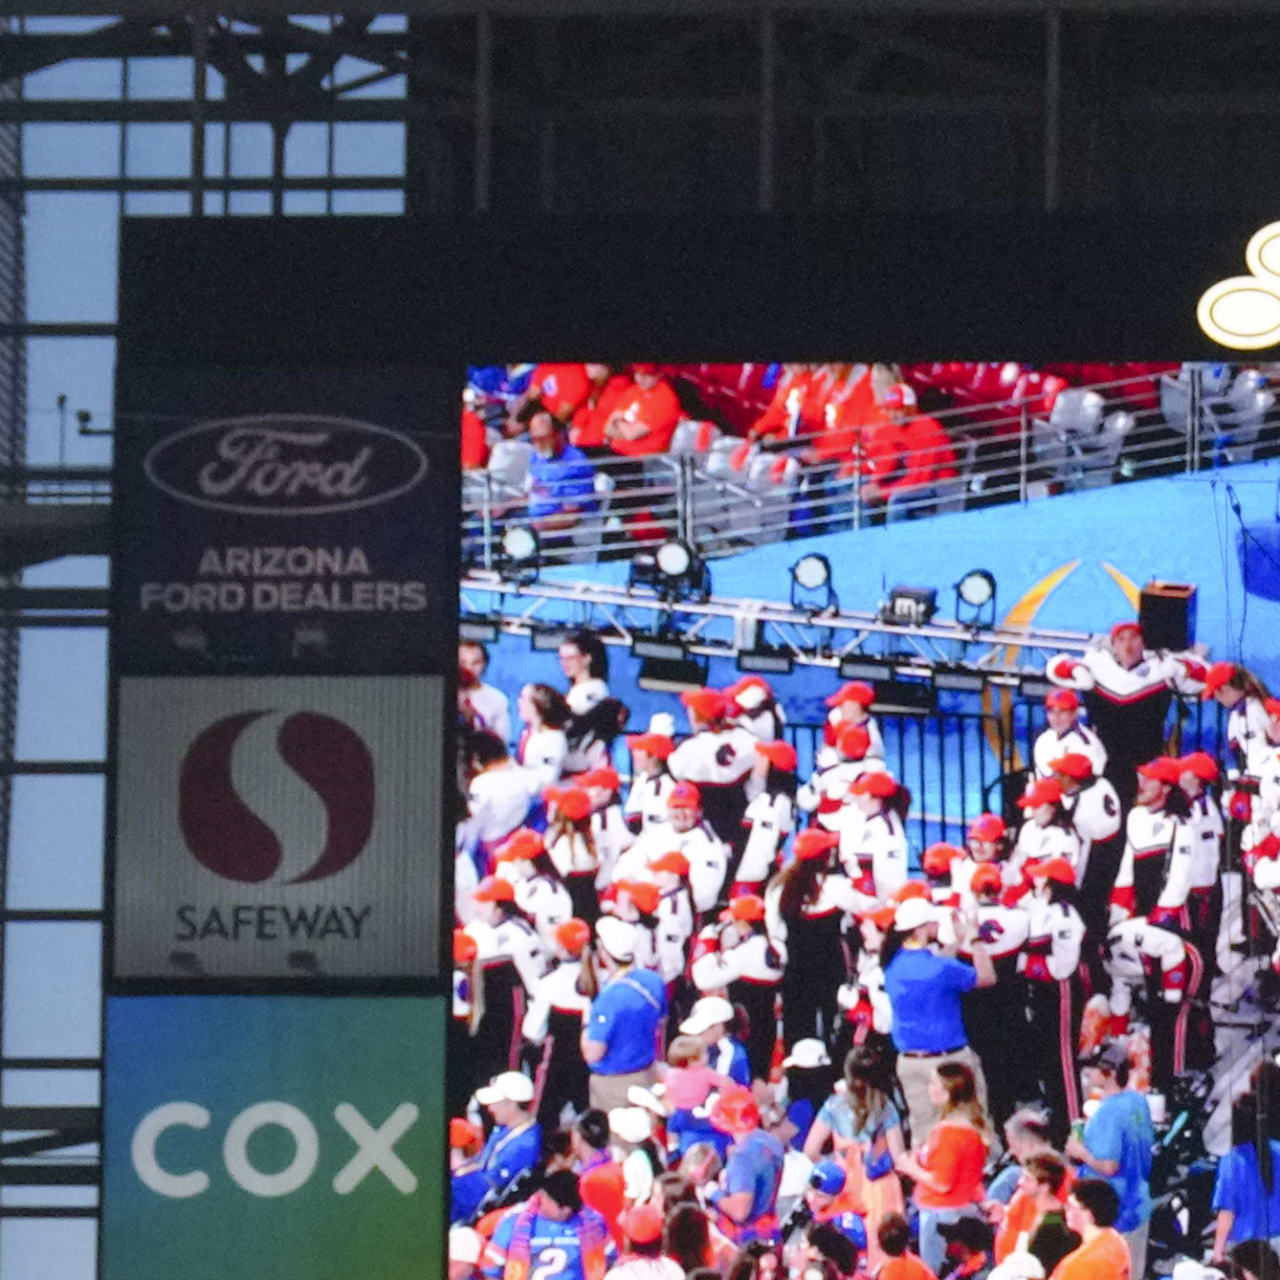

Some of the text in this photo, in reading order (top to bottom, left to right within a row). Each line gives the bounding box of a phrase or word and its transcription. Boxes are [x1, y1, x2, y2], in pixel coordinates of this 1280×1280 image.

[200, 427, 371, 497] Ford
[198, 546, 370, 577] ARIZONA
[140, 581, 427, 614] FORD DEALERS
[176, 905, 371, 941] SAFEWAY
[131, 1101, 420, 1198] COX
